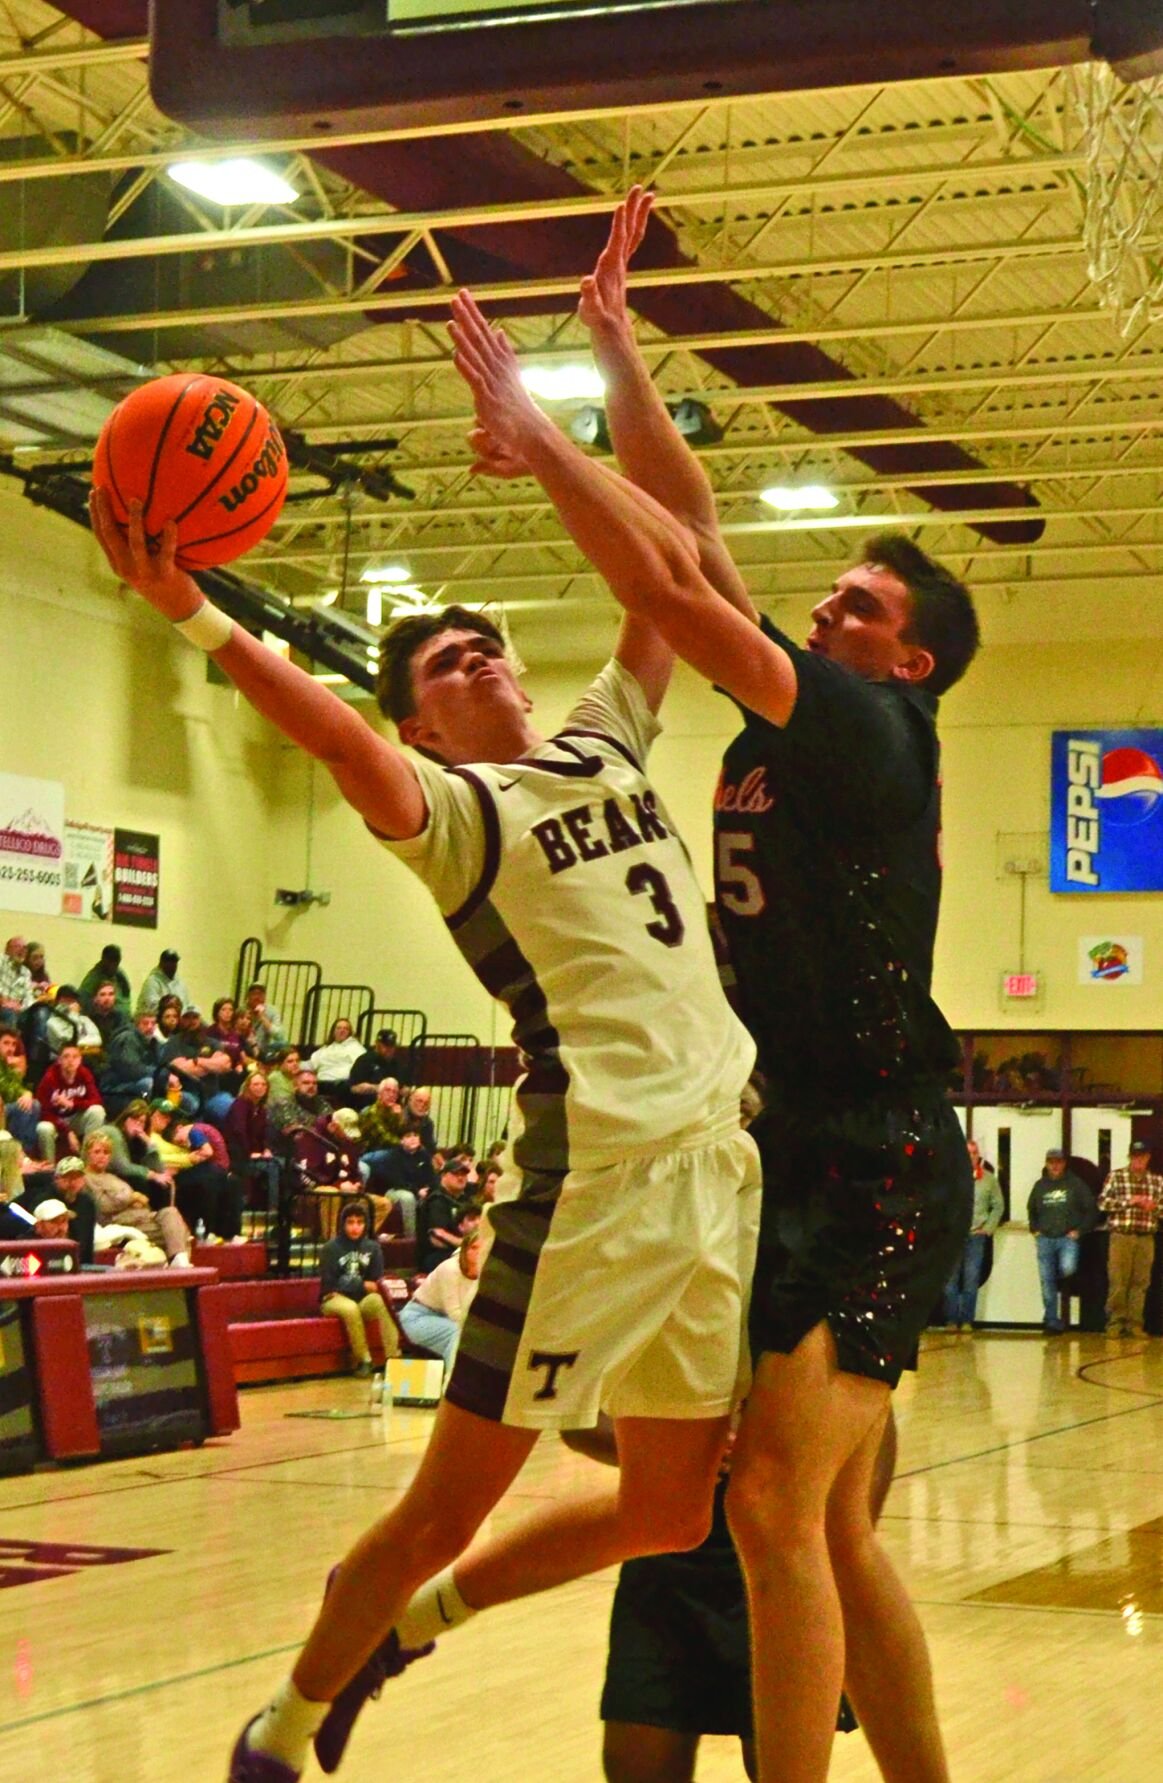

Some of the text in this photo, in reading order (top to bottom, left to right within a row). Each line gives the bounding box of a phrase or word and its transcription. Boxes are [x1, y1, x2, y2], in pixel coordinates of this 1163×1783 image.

[186, 388, 240, 461] NCAA
[1067, 738, 1100, 886] PEPSI
[115, 867, 158, 887] BUILDERS
[625, 862, 685, 948] 3
[1009, 976, 1031, 993] EXIT
[527, 1349, 581, 1401] T
